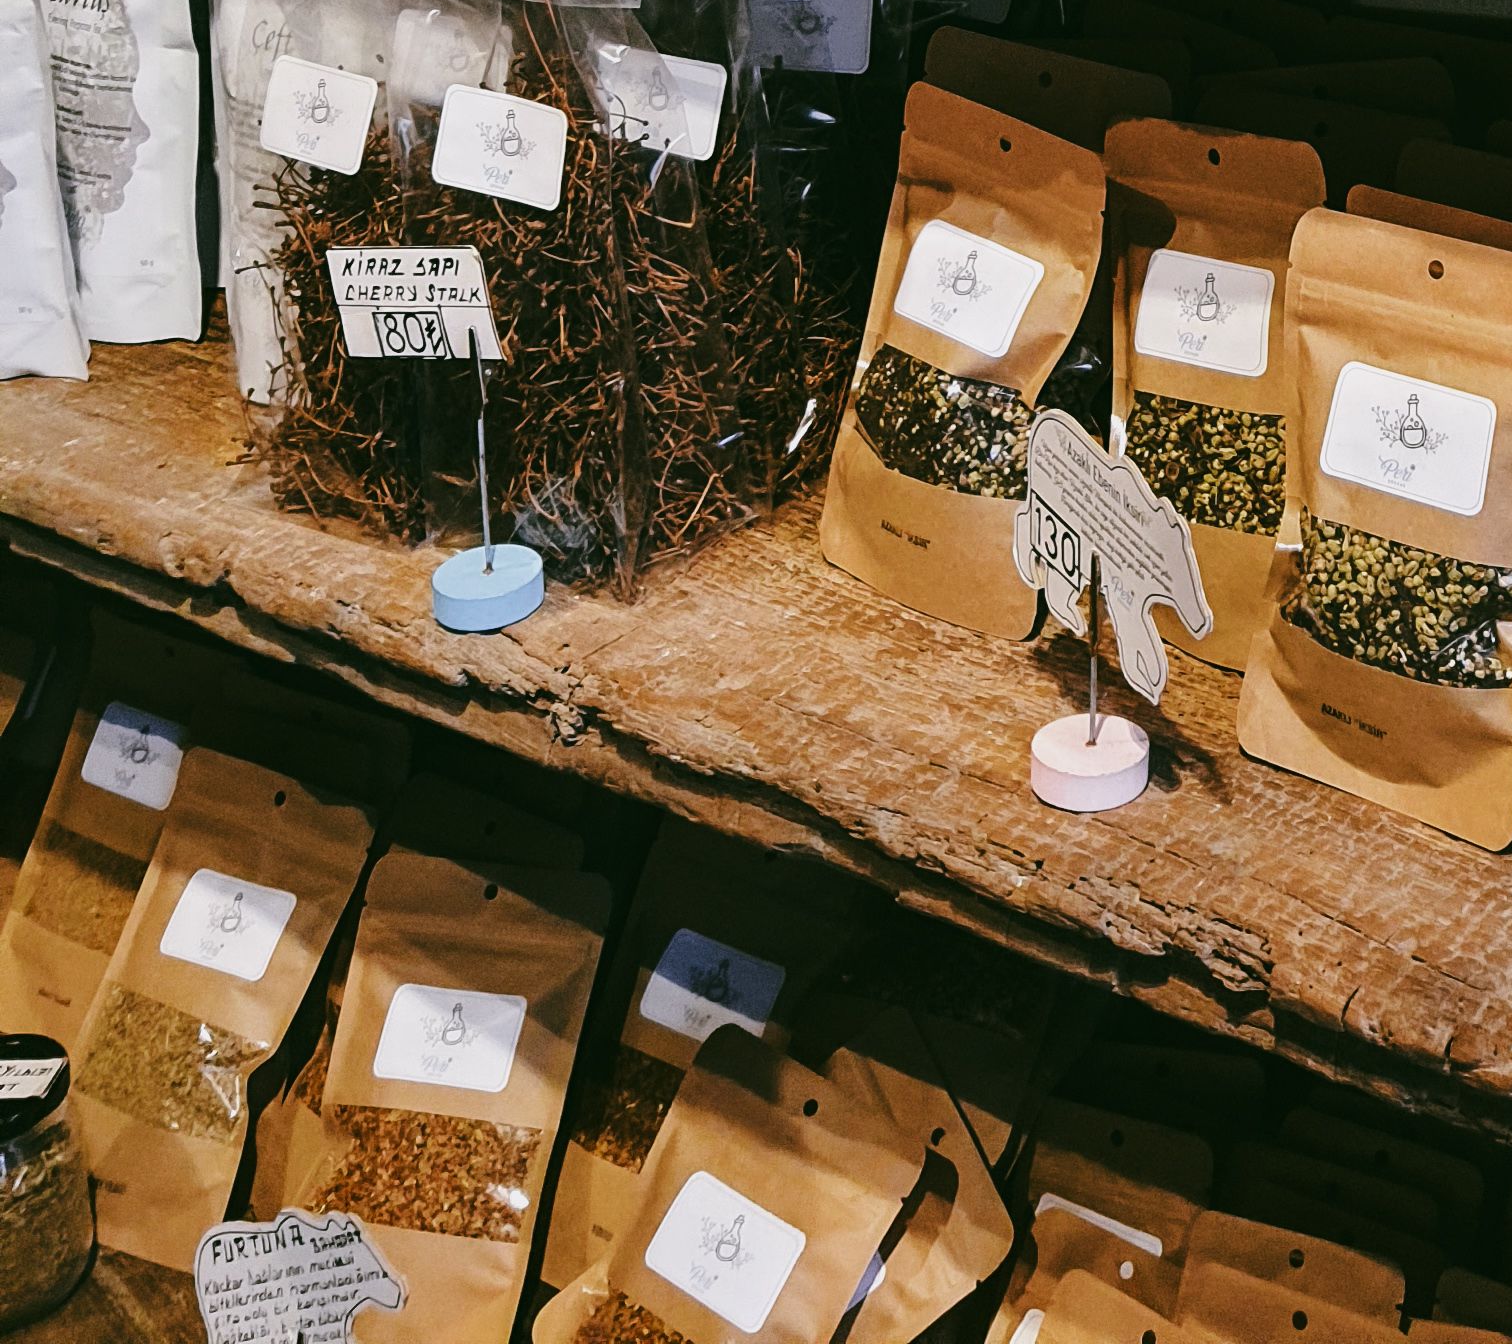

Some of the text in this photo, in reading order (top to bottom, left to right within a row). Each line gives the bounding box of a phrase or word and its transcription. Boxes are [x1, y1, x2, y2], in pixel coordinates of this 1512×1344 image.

[413, 257, 460, 277] SAPI
[345, 283, 482, 303] CHERRY STALK
[211, 1223, 306, 1265] FURTUNA
